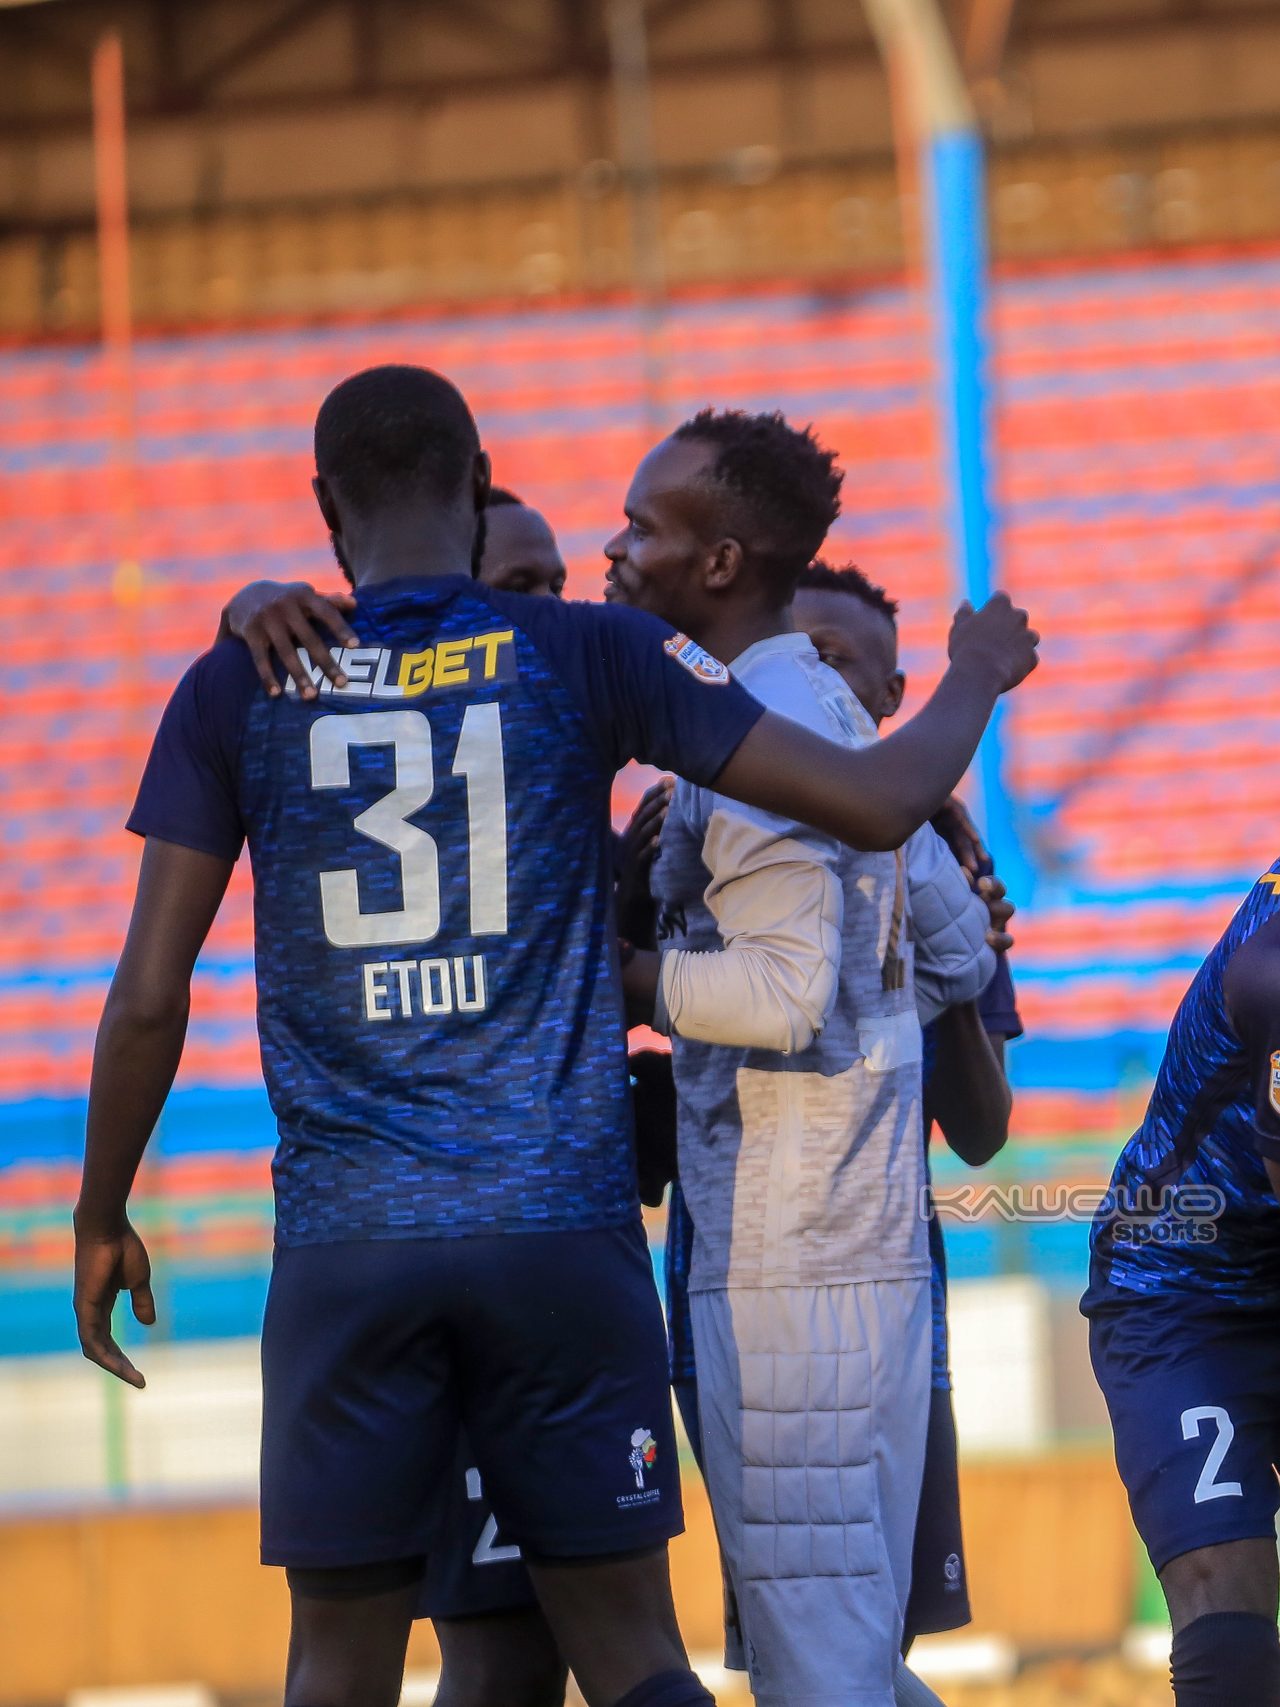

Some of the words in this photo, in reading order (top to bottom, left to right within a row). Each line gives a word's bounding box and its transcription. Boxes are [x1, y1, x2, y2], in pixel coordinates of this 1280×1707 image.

[310, 702, 508, 948] 31
[363, 955, 486, 1021] ETOU
[1180, 1406, 1243, 1504] 2
[616, 1493, 643, 1503] CRYSTAL
